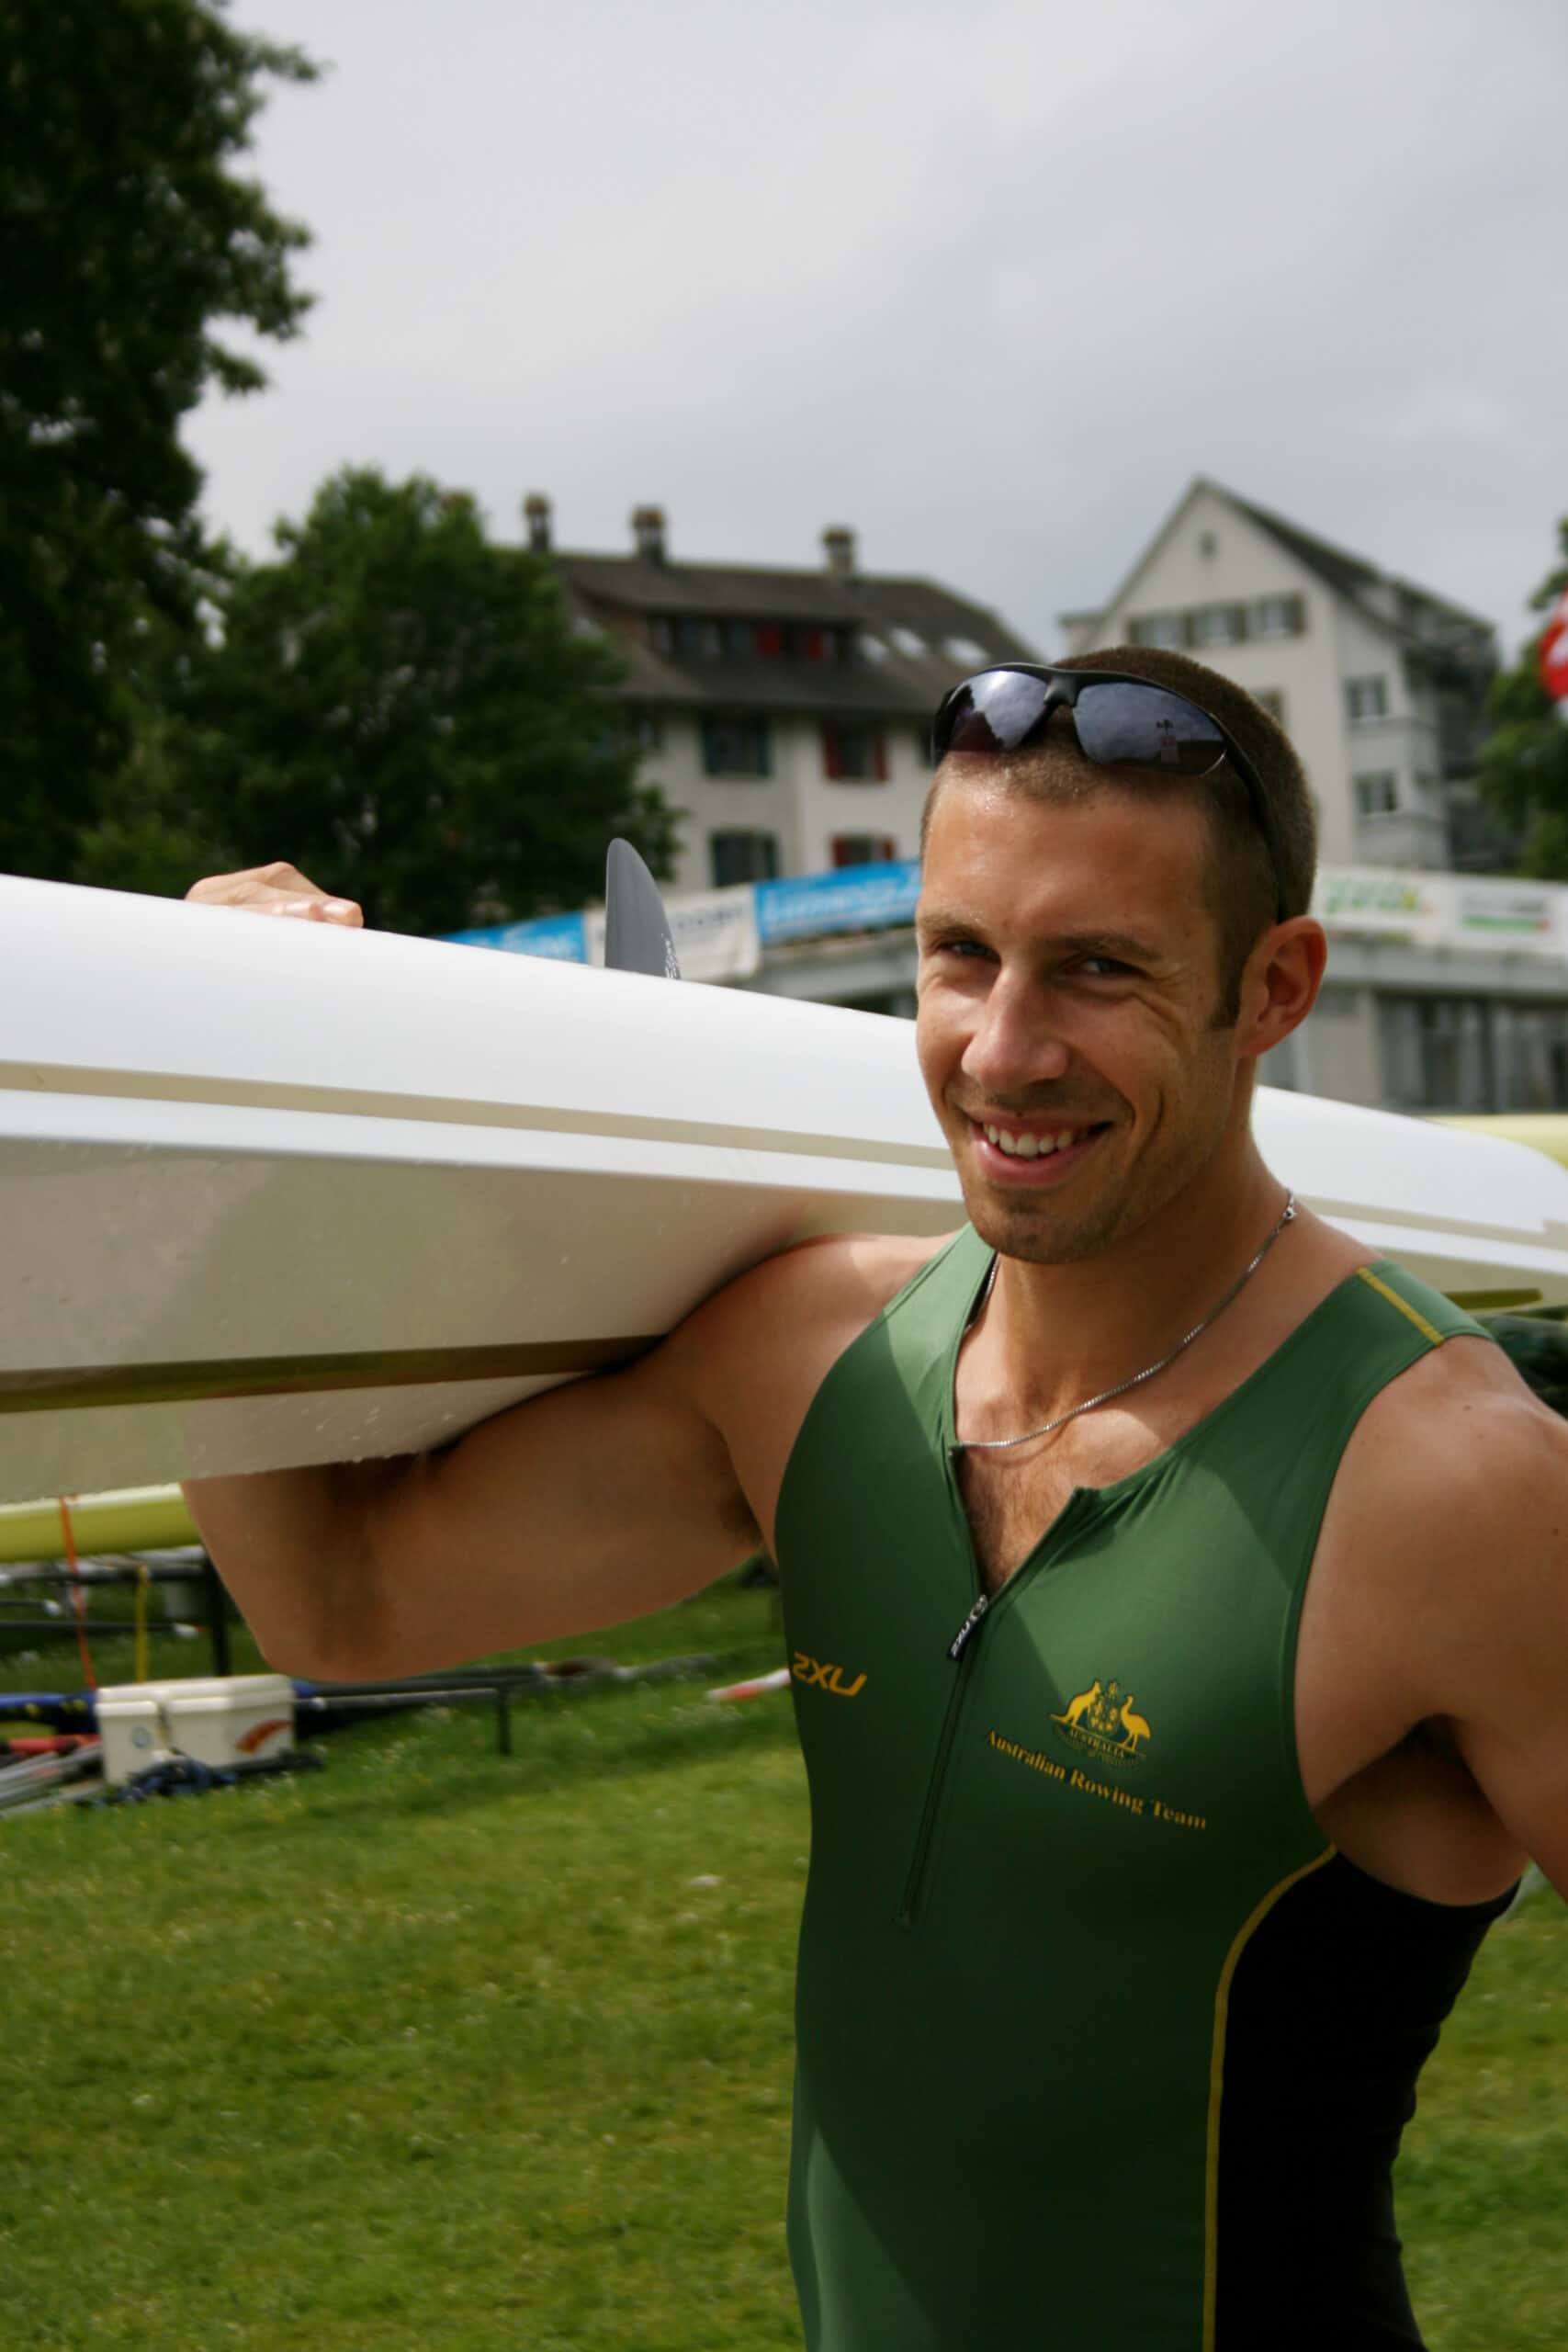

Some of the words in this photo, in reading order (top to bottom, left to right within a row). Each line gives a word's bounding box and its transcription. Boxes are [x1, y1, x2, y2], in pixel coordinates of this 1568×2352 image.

[793, 1650, 868, 1696] 2XU
[986, 1729, 1066, 1781] Australian
[1070, 1768, 1143, 1815] Rowing
[1153, 1799, 1207, 1830] Team
